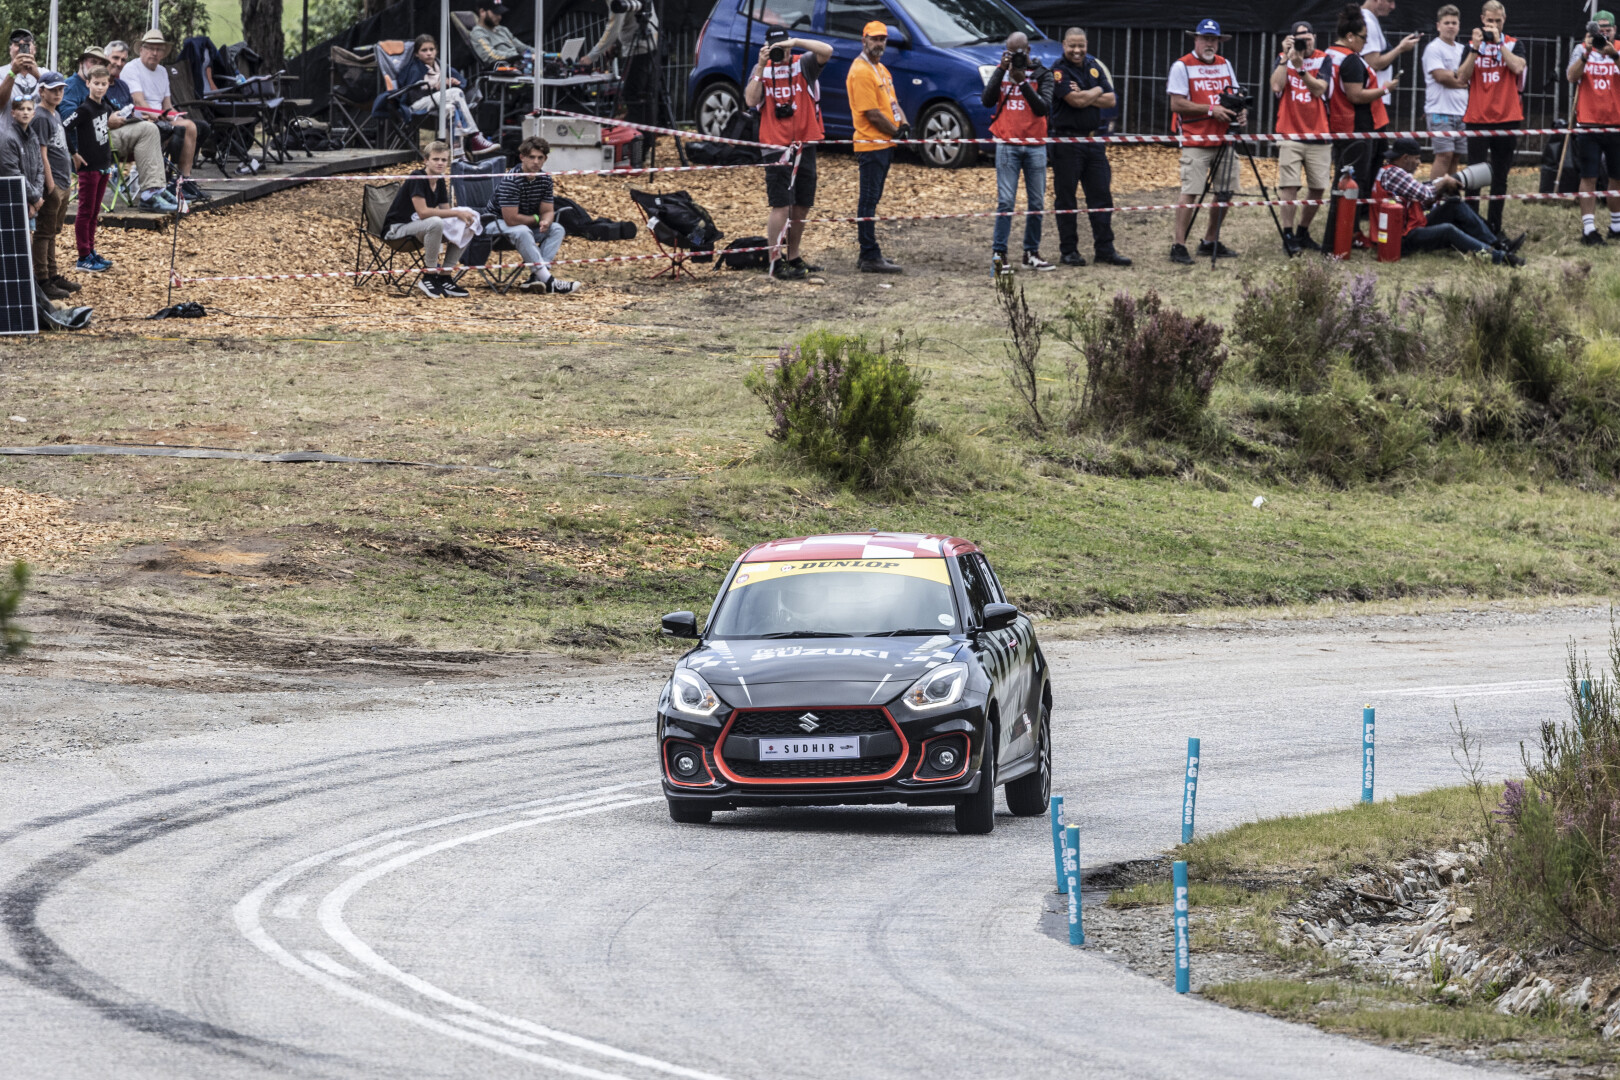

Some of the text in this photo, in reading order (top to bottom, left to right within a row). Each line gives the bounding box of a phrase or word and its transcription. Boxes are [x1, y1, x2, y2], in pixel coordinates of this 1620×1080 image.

[1475, 57, 1507, 68] MEDI
[1584, 64, 1620, 75] MEDIA
[1482, 71, 1500, 83] 116
[1194, 79, 1230, 91] MEDIA
[1291, 90, 1312, 103] 145
[1007, 100, 1025, 110] 135
[798, 561, 900, 569] DUNLOP
[750, 648, 889, 661] SUZUKI
[784, 743, 835, 754] SUDHIR
[1364, 723, 1374, 789] PG GLASS
[1184, 756, 1198, 825] PG GLASS
[1067, 848, 1077, 924] PG GLASS
[1175, 886, 1188, 969] PG GLASS
